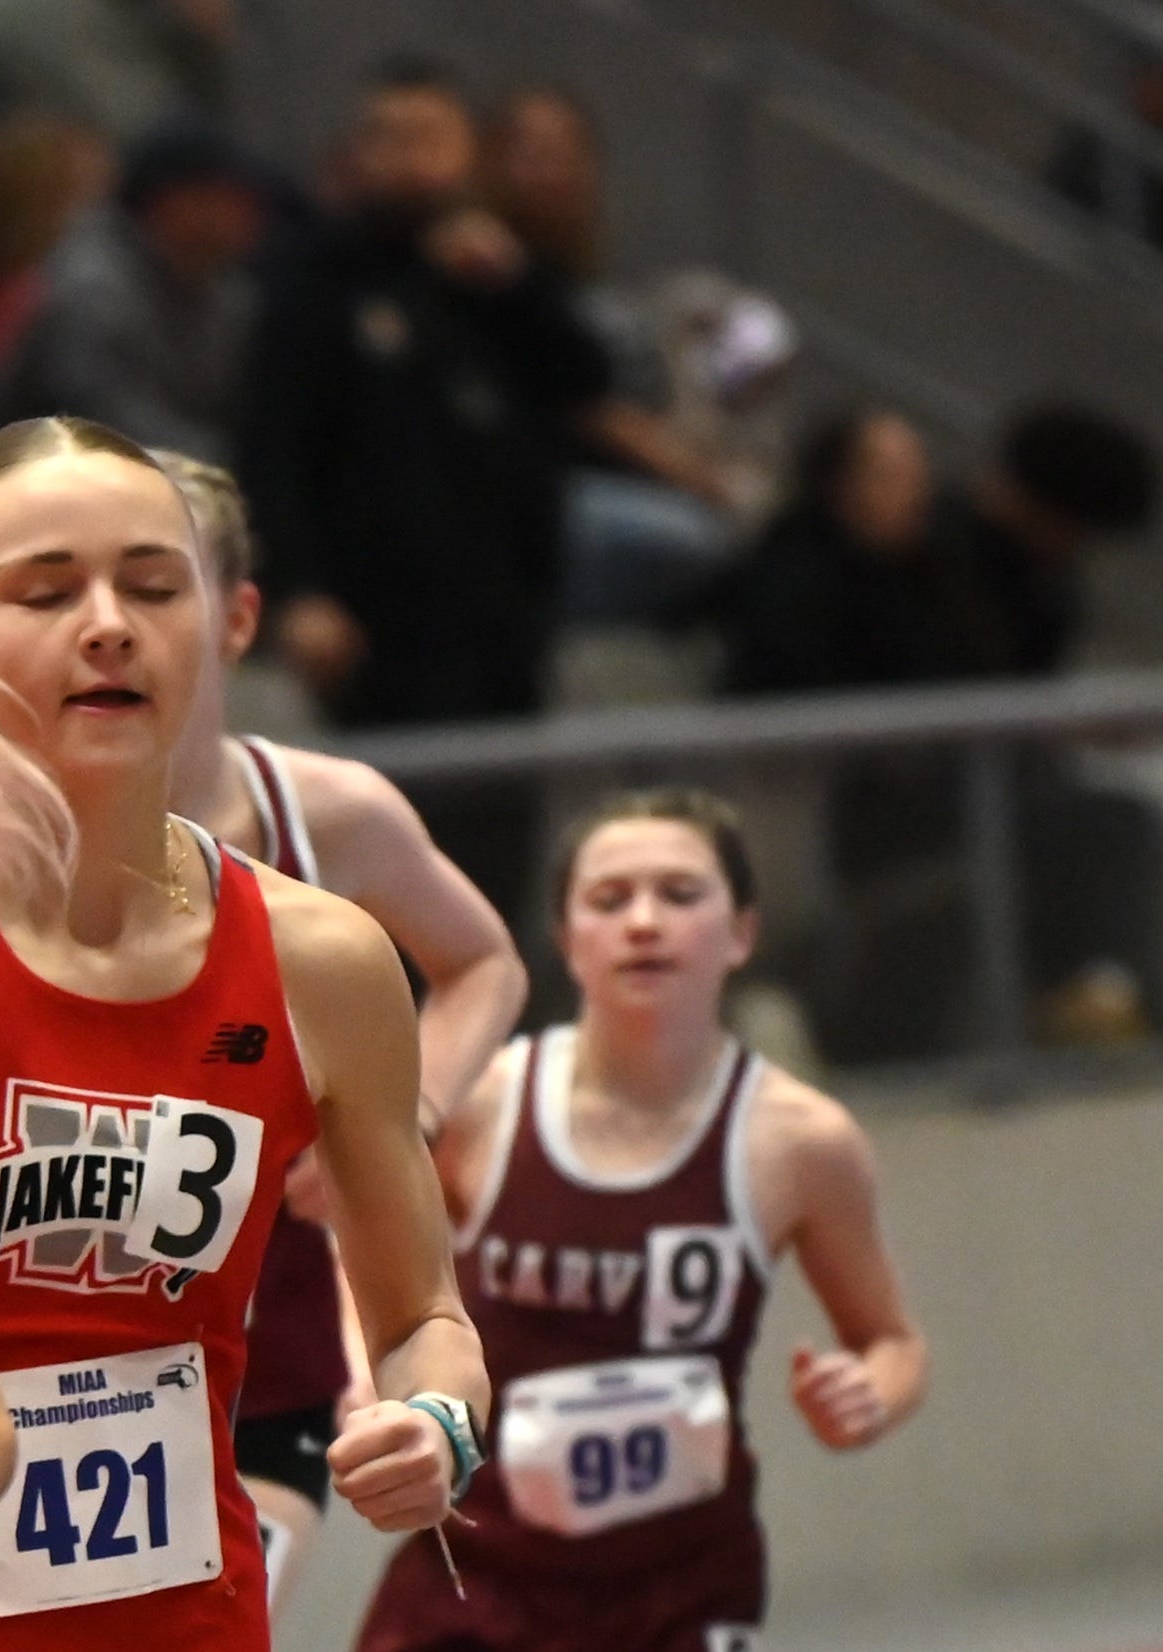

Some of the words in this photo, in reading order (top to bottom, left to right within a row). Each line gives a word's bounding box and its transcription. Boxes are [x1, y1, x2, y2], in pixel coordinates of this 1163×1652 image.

[150, 1112, 237, 1259] 3
[481, 1236, 641, 1314] CARV
[669, 1239, 720, 1339] 9
[58, 1368, 107, 1397] MIAA
[15, 1440, 169, 1567] 421
[568, 1423, 668, 1507] 99
